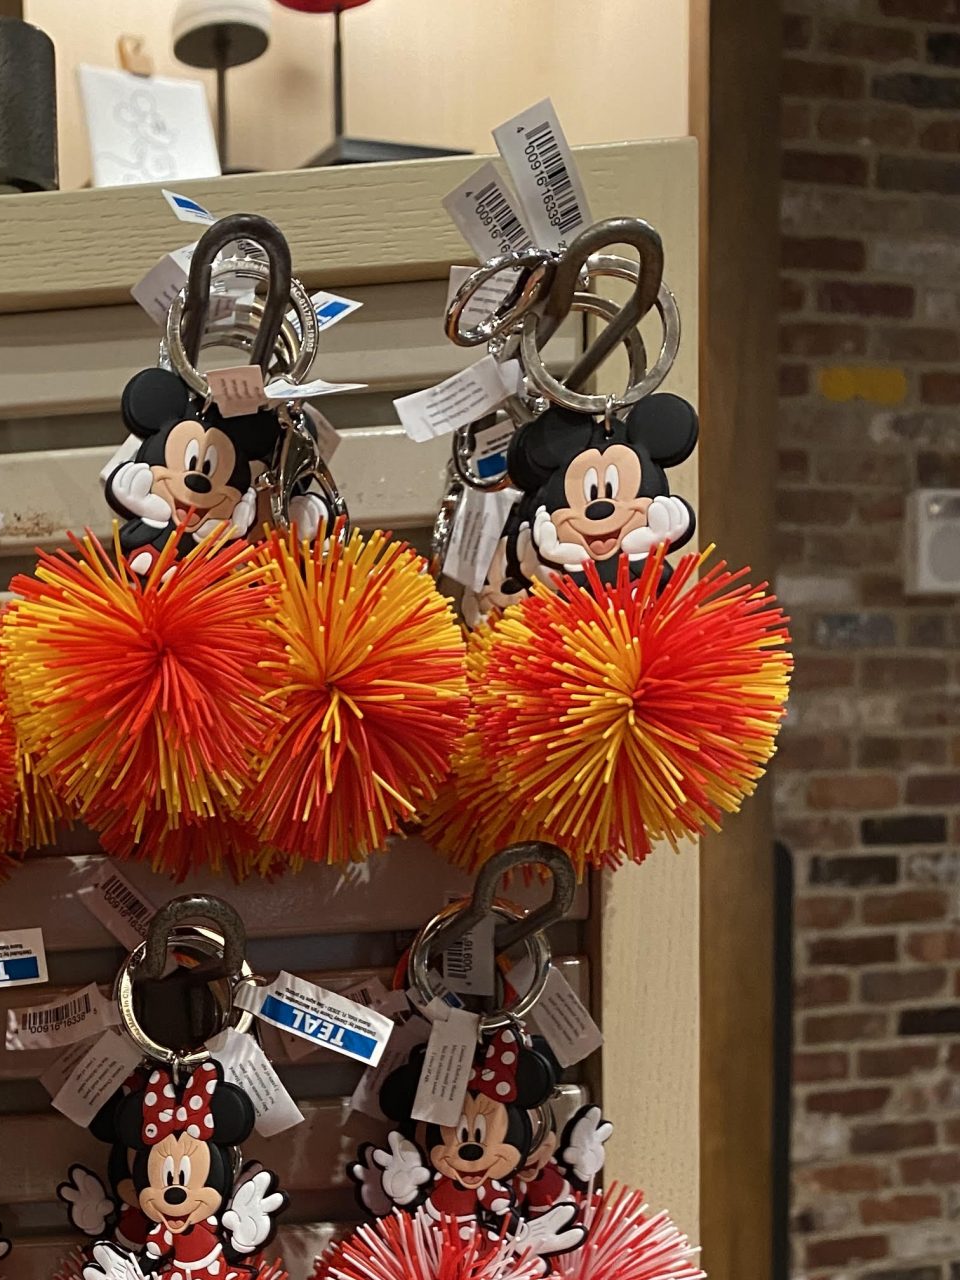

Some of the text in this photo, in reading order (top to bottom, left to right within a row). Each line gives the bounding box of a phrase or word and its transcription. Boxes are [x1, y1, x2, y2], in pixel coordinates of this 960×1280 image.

[515, 125, 523, 133] 4
[522, 145, 548, 187] 00916
[537, 188, 564, 227] 16339
[463, 190, 472, 198] 4
[472, 203, 502, 239] 00916
[287, 1006, 348, 1048] TEAL
